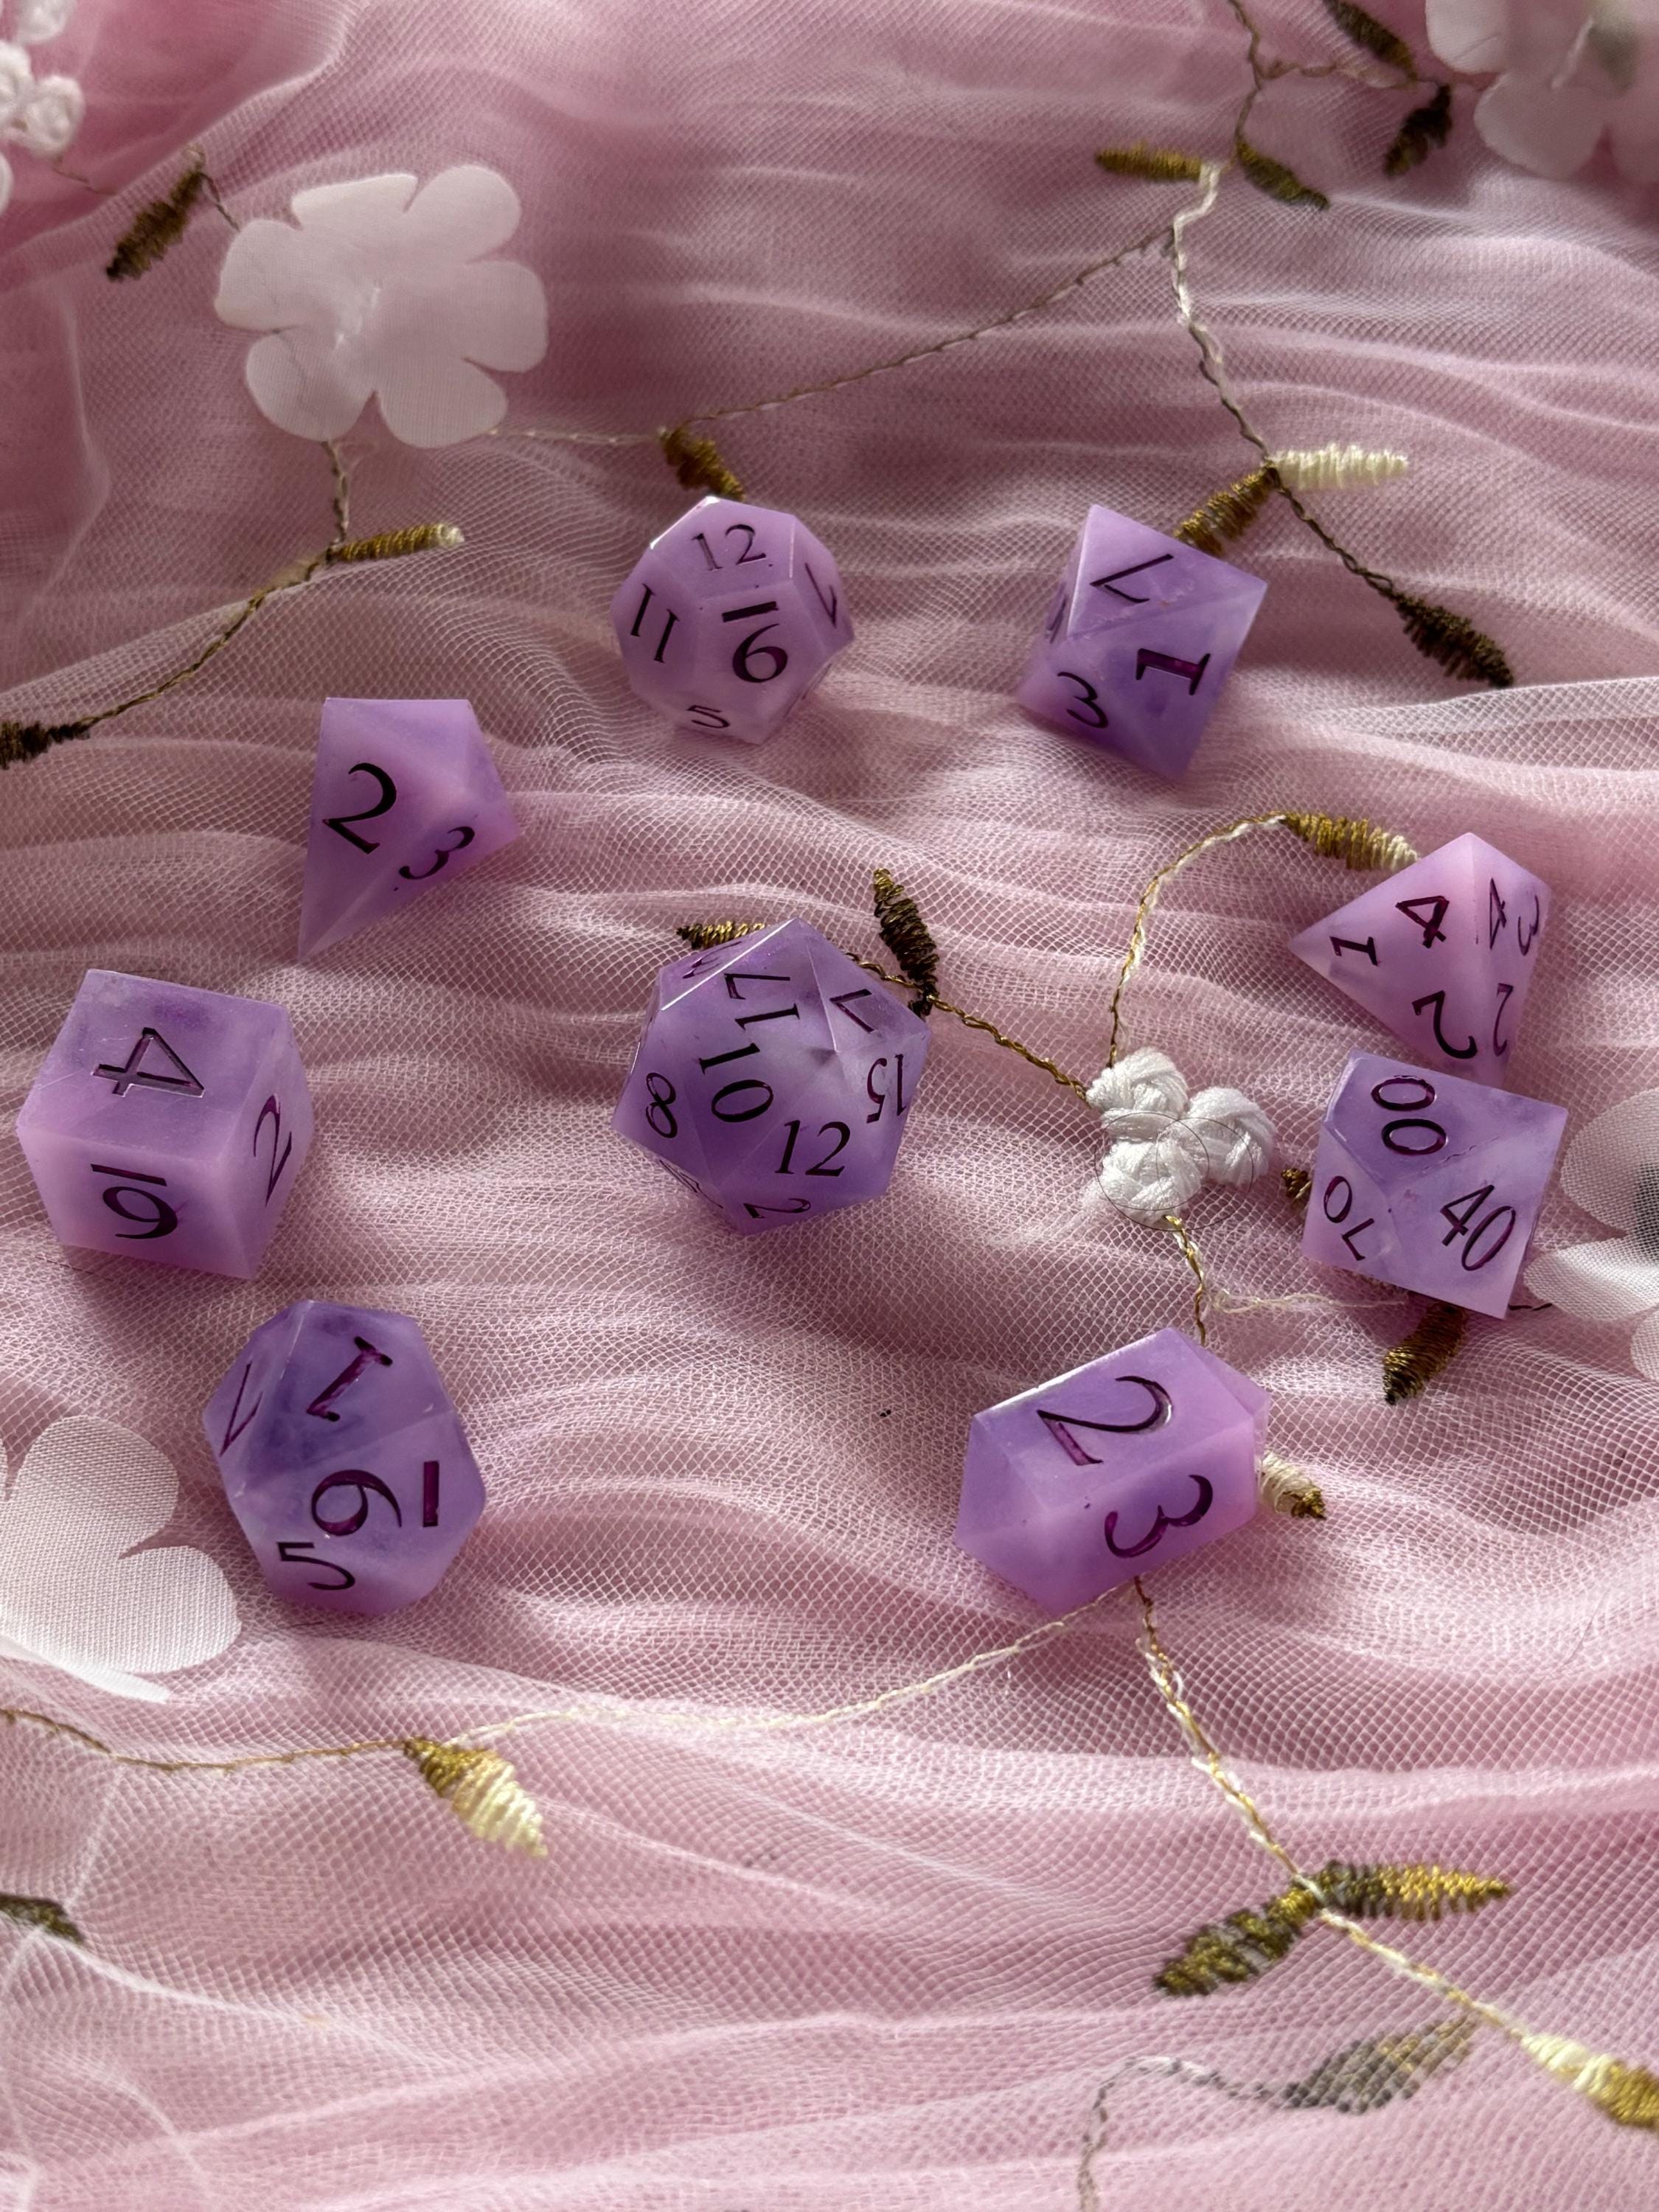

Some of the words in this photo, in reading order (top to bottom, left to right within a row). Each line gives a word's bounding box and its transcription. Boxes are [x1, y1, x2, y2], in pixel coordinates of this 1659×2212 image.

[690, 524, 767, 571] 12
[1089, 553, 1175, 604] 7
[630, 582, 680, 664] 11
[1057, 671, 1109, 728] 3
[1135, 647, 1211, 696] 1
[685, 704, 731, 729] 5
[321, 762, 397, 855] 2
[398, 826, 476, 880] 3
[1394, 895, 1450, 949] 4
[1489, 877, 1507, 950] 4
[1517, 894, 1540, 956] 3
[1329, 936, 1379, 967] 1
[1411, 989, 1478, 1060] 2
[91, 1026, 206, 1098] 4
[698, 1042, 776, 1124] 10
[866, 1053, 908, 1124] 15
[644, 1071, 678, 1139] 8
[1370, 1074, 1449, 1157] 00
[253, 1093, 293, 1208] 2
[774, 1119, 852, 1178] 12
[742, 1197, 811, 1220] 2
[1323, 1175, 1375, 1262] 70
[1439, 1183, 1517, 1272] 40
[305, 1335, 394, 1422] 1
[1036, 1375, 1175, 1467] 2
[1104, 1474, 1214, 1559] 3
[276, 1540, 357, 1592] 5
